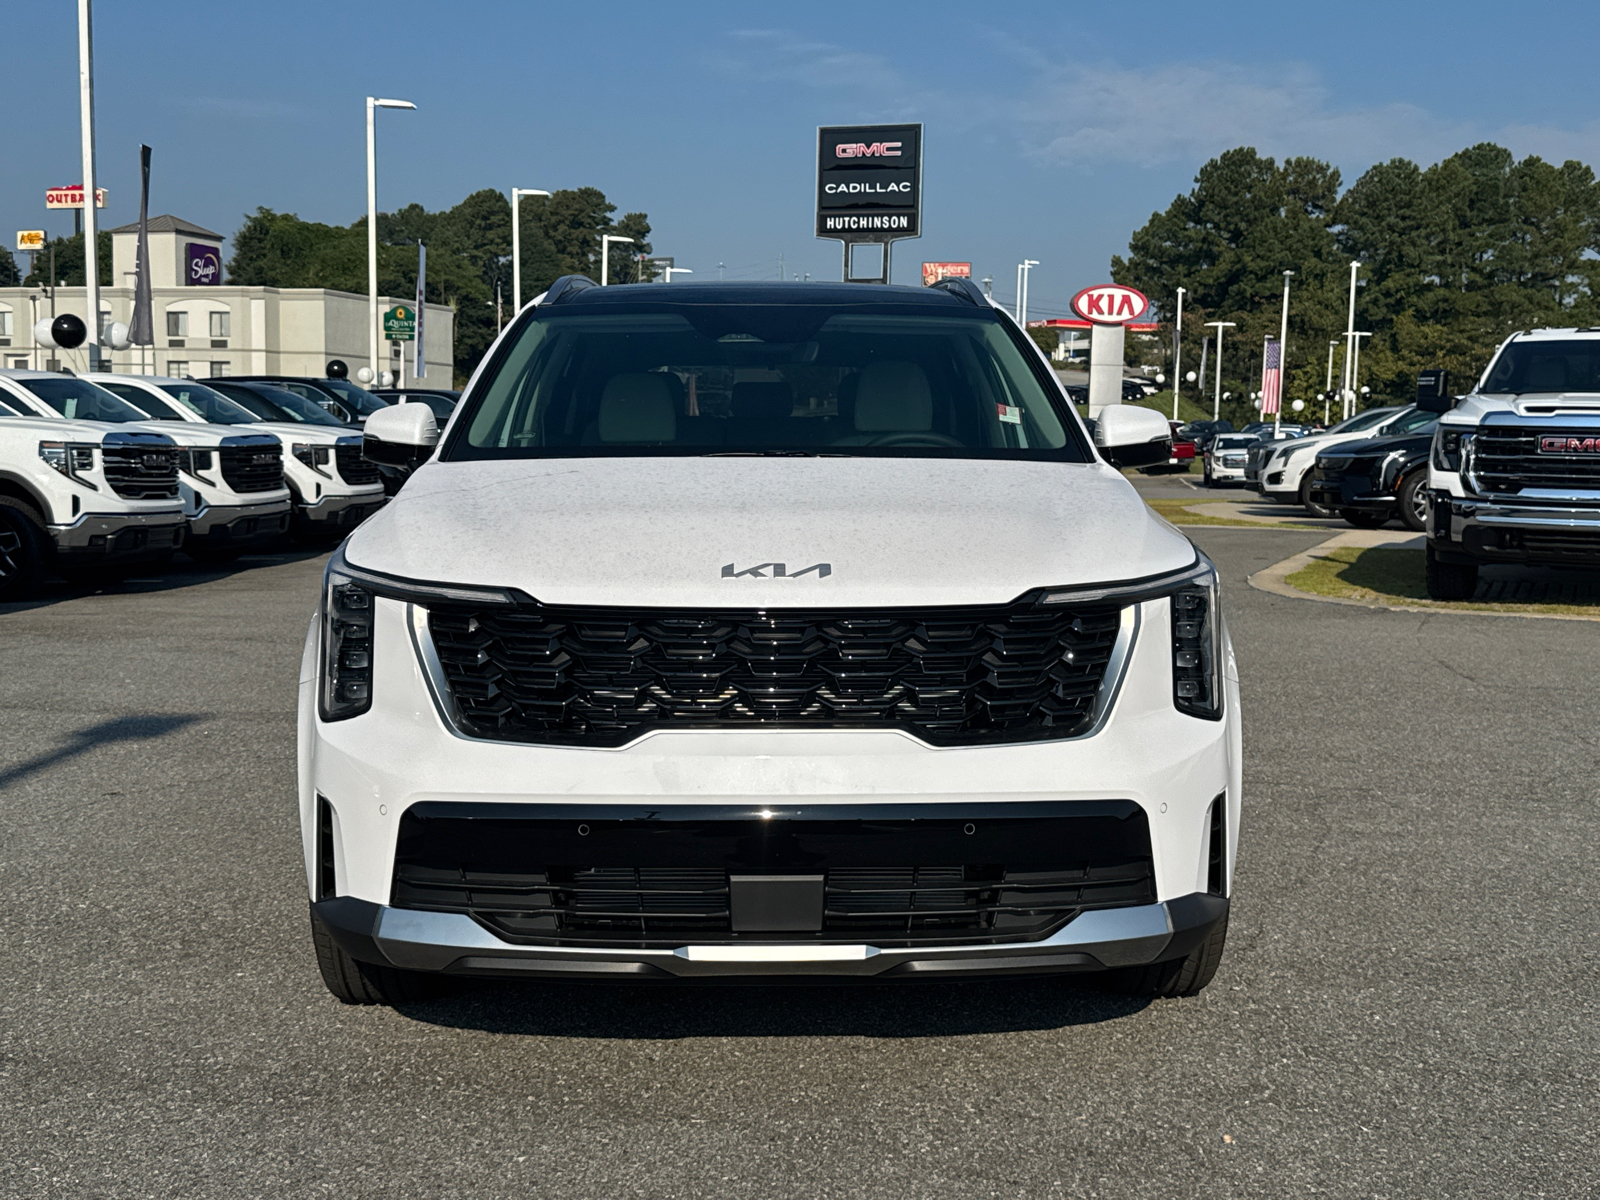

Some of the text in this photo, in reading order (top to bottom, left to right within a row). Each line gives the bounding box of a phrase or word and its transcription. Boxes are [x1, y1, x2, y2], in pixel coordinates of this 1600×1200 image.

[835, 142, 902, 158] GMC
[825, 182, 911, 194] CADILLAC
[46, 193, 102, 204] OUTBAK
[826, 216, 908, 229] HUTCHINSON
[191, 258, 215, 280] Sleep
[1087, 293, 1136, 316] KIA
[1541, 437, 1600, 451] GM
[721, 563, 832, 579] KIA
